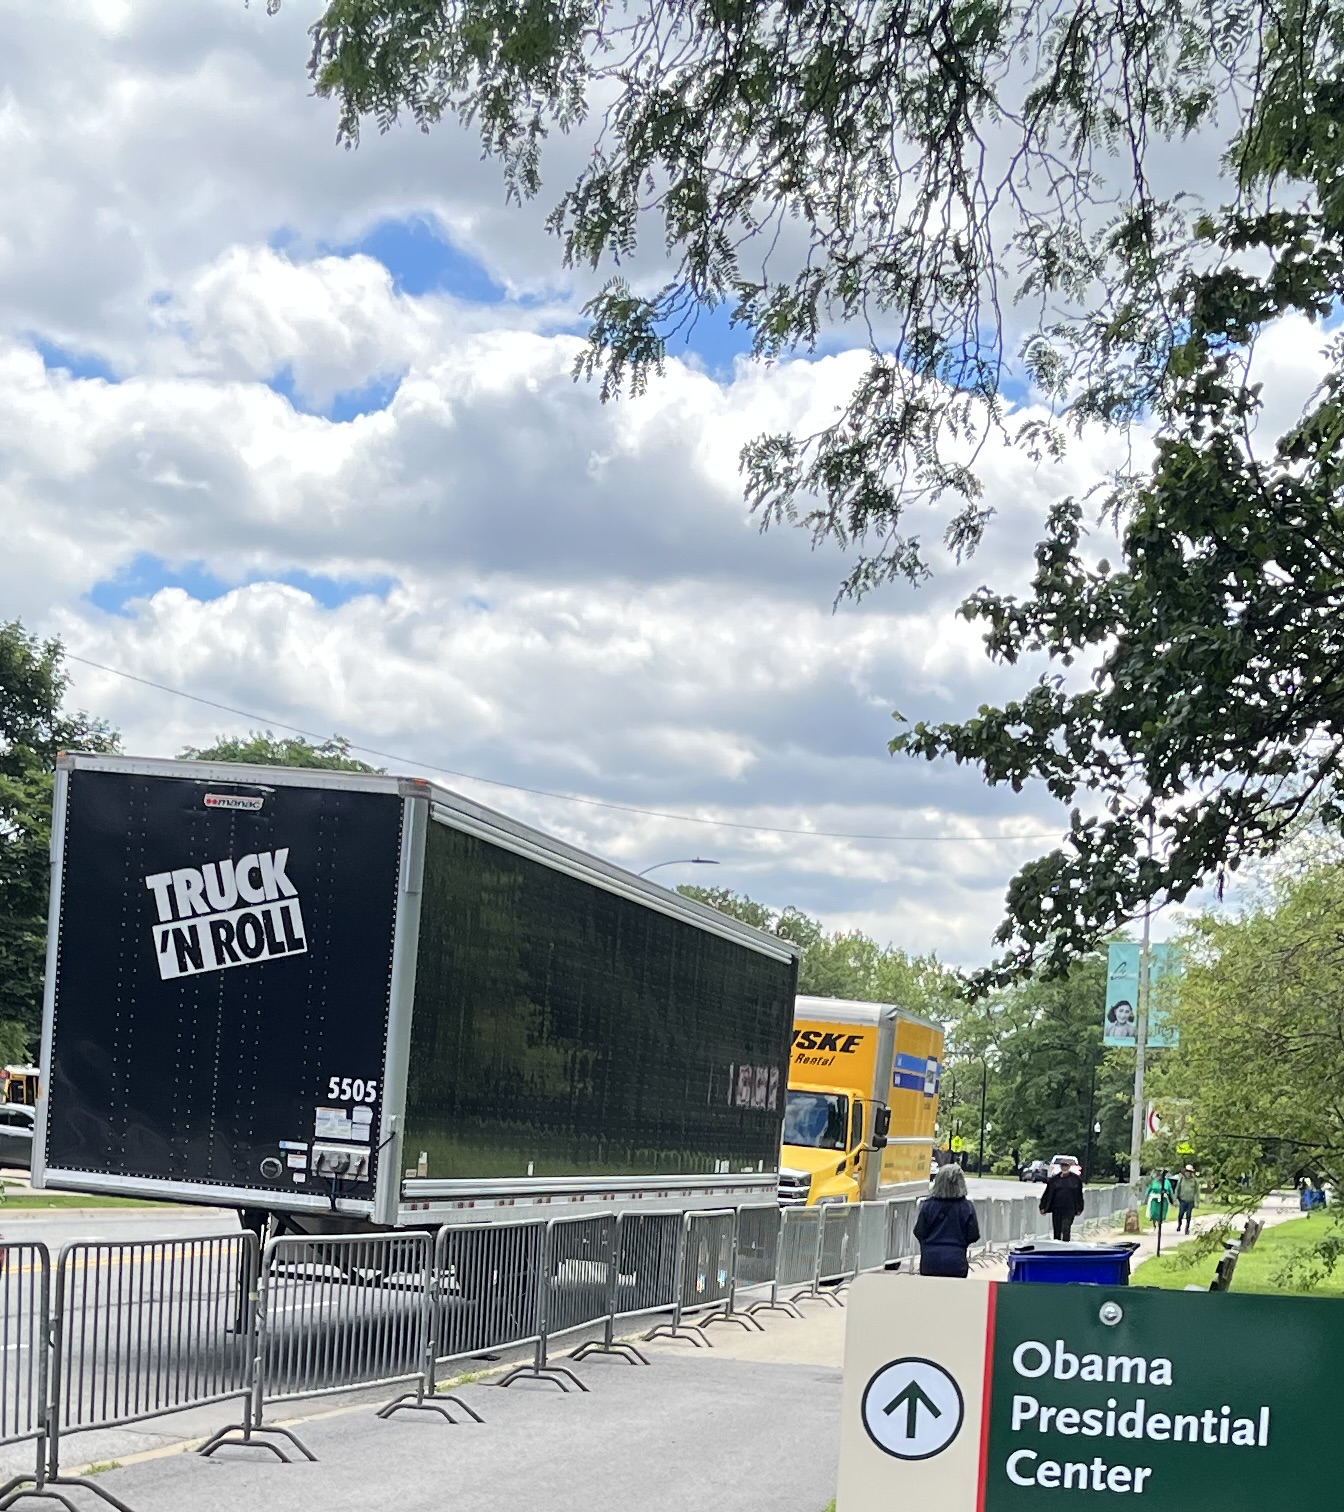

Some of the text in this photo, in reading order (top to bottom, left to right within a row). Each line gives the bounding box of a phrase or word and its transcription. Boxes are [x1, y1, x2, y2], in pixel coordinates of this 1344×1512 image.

[145, 848, 299, 922] TRUCK
[209, 905, 305, 966] ROLL
[794, 1053, 836, 1066] Rental
[327, 1077, 377, 1103] 5505
[1012, 1339, 1173, 1386] Obama
[1011, 1395, 1270, 1447] Presidential
[1005, 1449, 1153, 1494] Center
